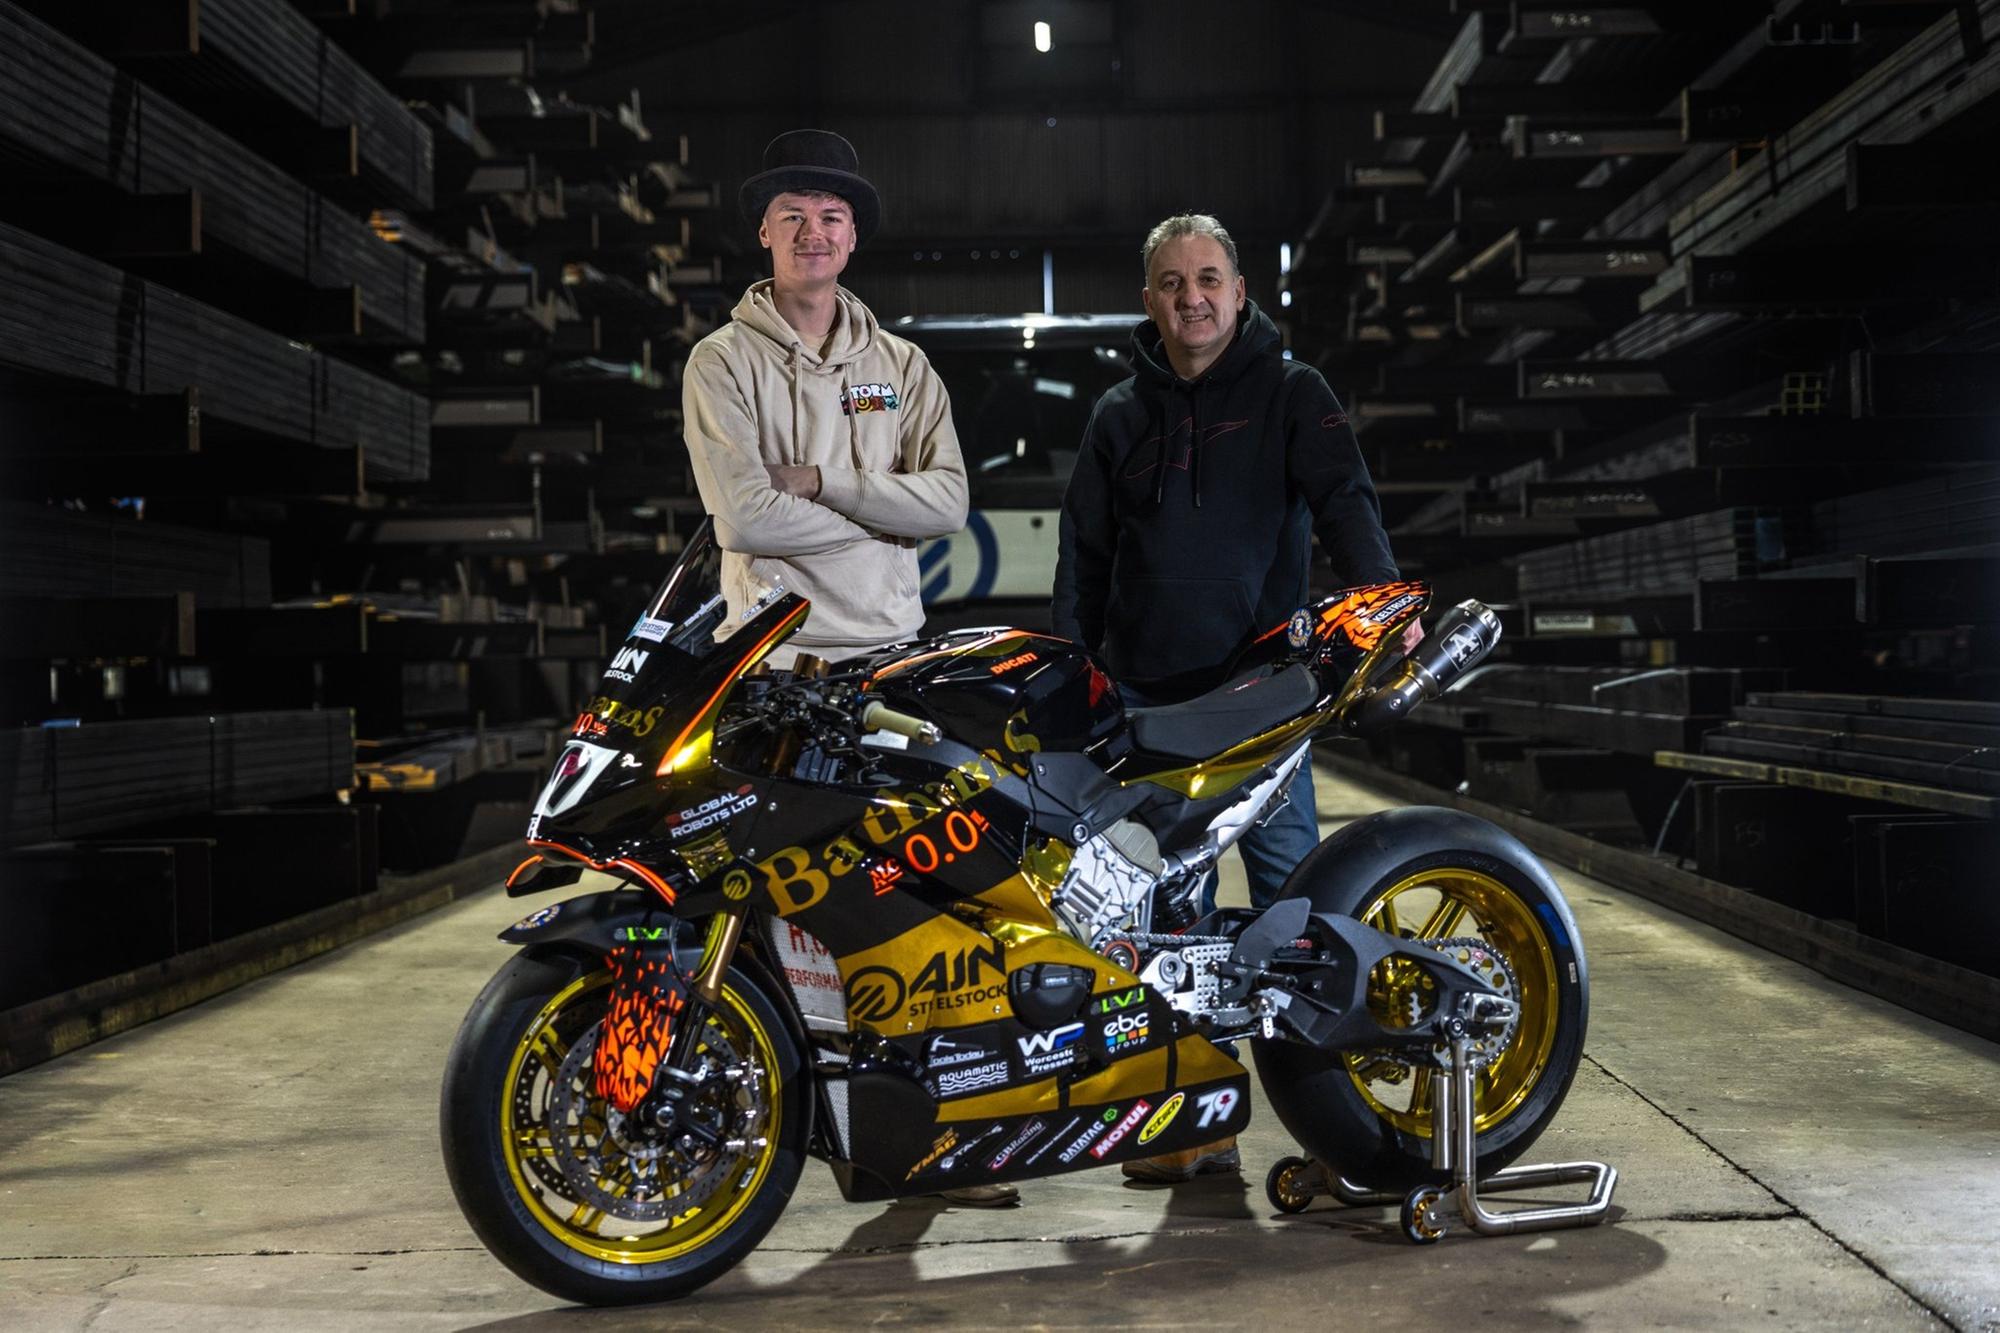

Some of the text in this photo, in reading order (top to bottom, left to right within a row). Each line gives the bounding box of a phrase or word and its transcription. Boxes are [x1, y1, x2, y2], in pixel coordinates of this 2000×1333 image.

[840, 382, 897, 401] TORM
[1372, 593, 1416, 623] KELTRUCK
[990, 652, 1039, 676] DUCATI
[671, 794, 758, 838] ROBOTS LTD
[681, 792, 740, 820] GLOBAL
[909, 944, 1007, 1000] AJN
[909, 982, 1009, 1017] STEELSTOCK
[1103, 1012, 1149, 1037] ebc
[1024, 1049, 1074, 1067] Worceste
[1108, 1036, 1147, 1054] group
[938, 1061, 1008, 1082] AQUAMATIC
[1031, 1057, 1075, 1073] Presses
[1197, 1087, 1240, 1128] 79
[1095, 1104, 1150, 1157] MOTUL
